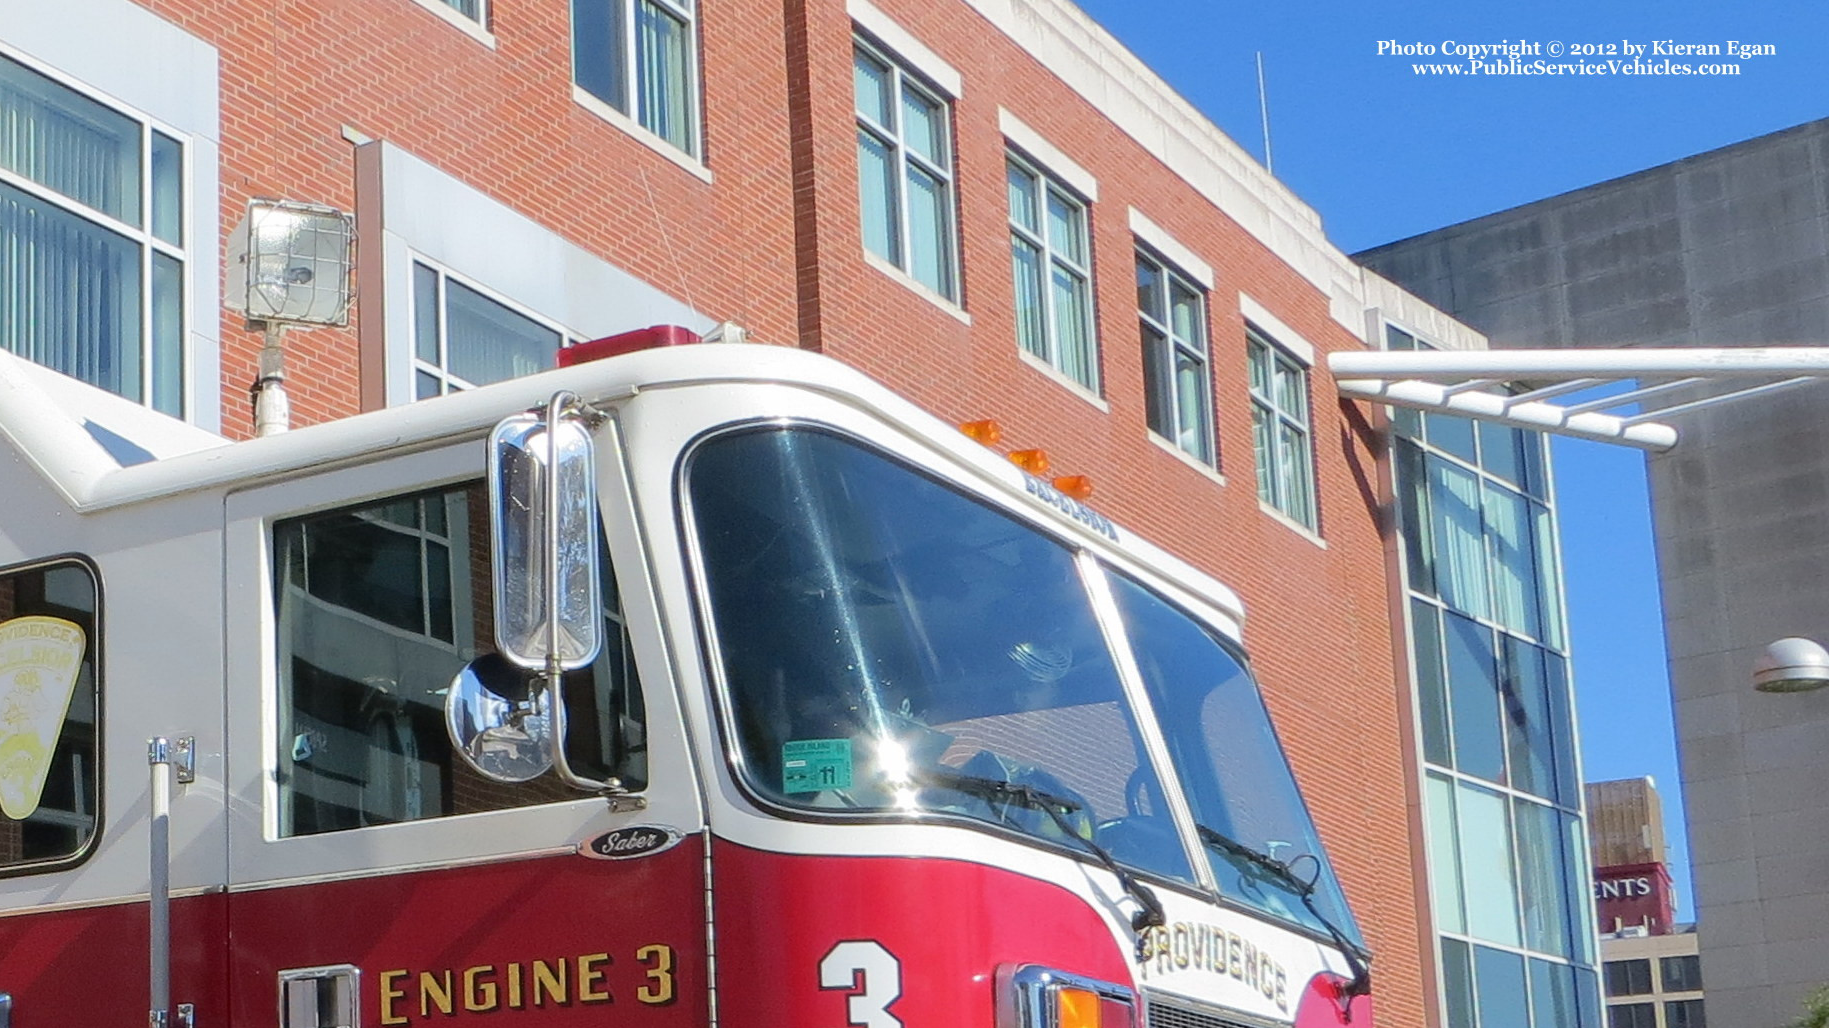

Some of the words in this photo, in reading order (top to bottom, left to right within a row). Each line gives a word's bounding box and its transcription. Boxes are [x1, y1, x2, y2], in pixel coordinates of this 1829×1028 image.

[601, 830, 658, 854] Saber
[379, 952, 613, 1027] ENGINE
[635, 943, 675, 1005] 3
[1137, 920, 1289, 1016] PROVIDENCE
